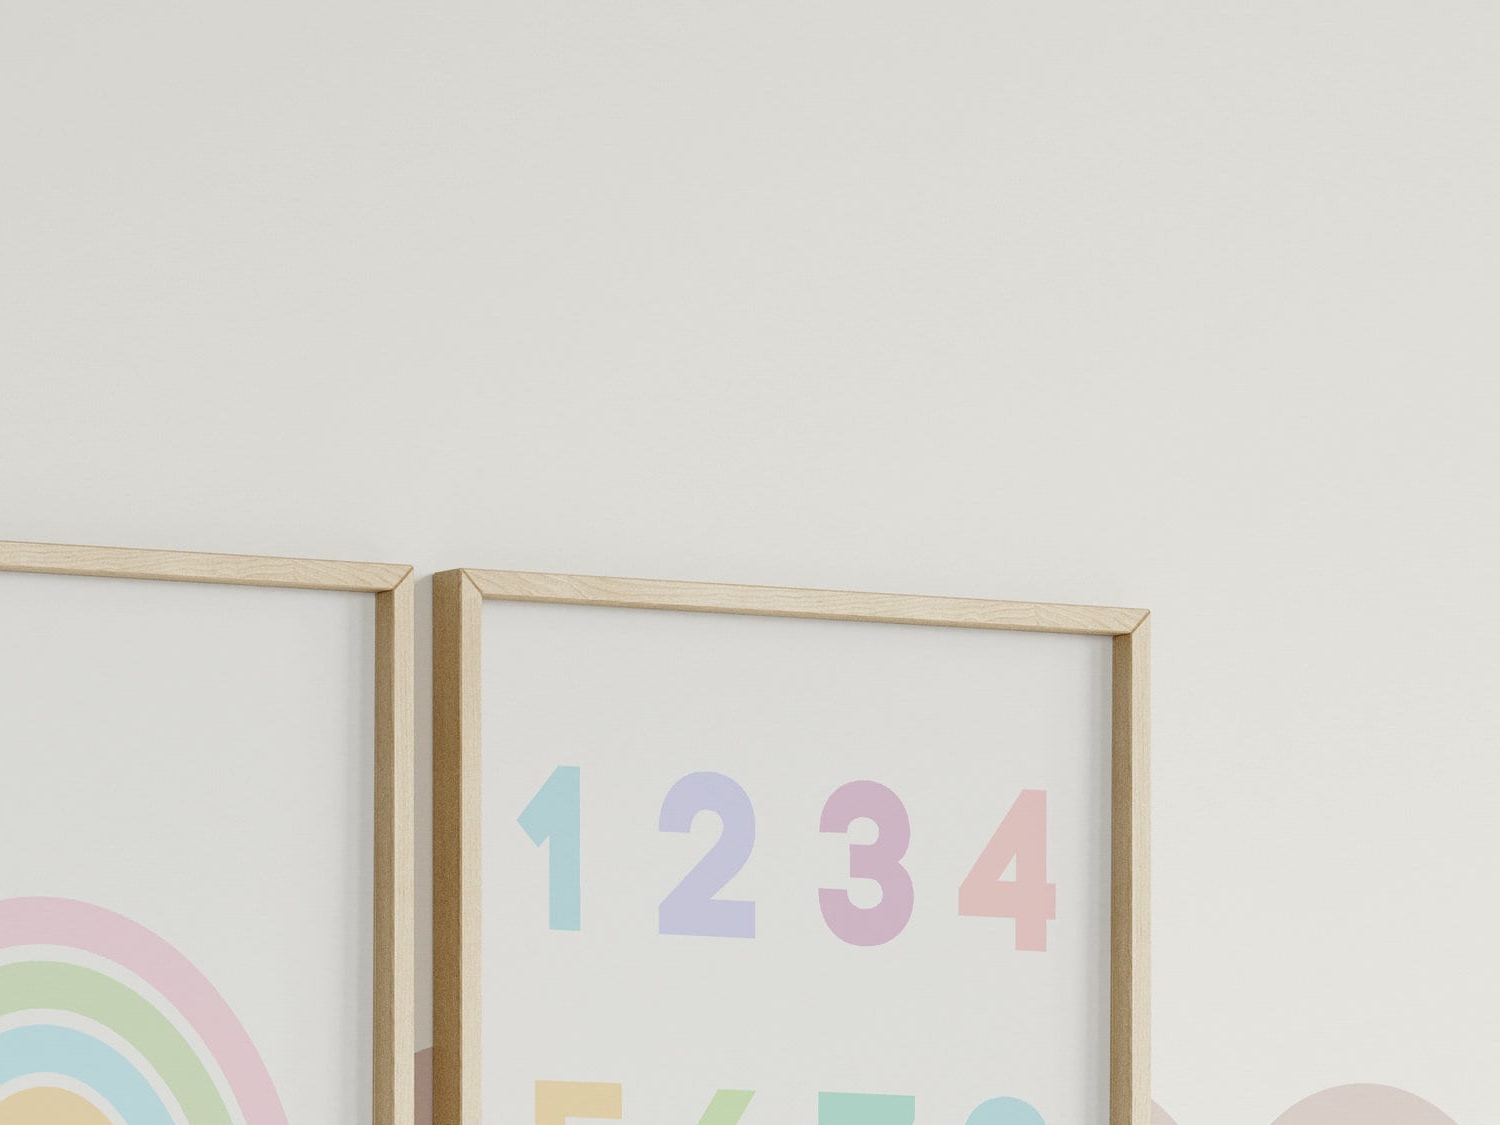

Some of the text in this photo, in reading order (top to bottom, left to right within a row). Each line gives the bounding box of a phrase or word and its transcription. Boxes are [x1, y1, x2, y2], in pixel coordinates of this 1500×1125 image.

[517, 765, 1056, 952] 1 2 3 4
